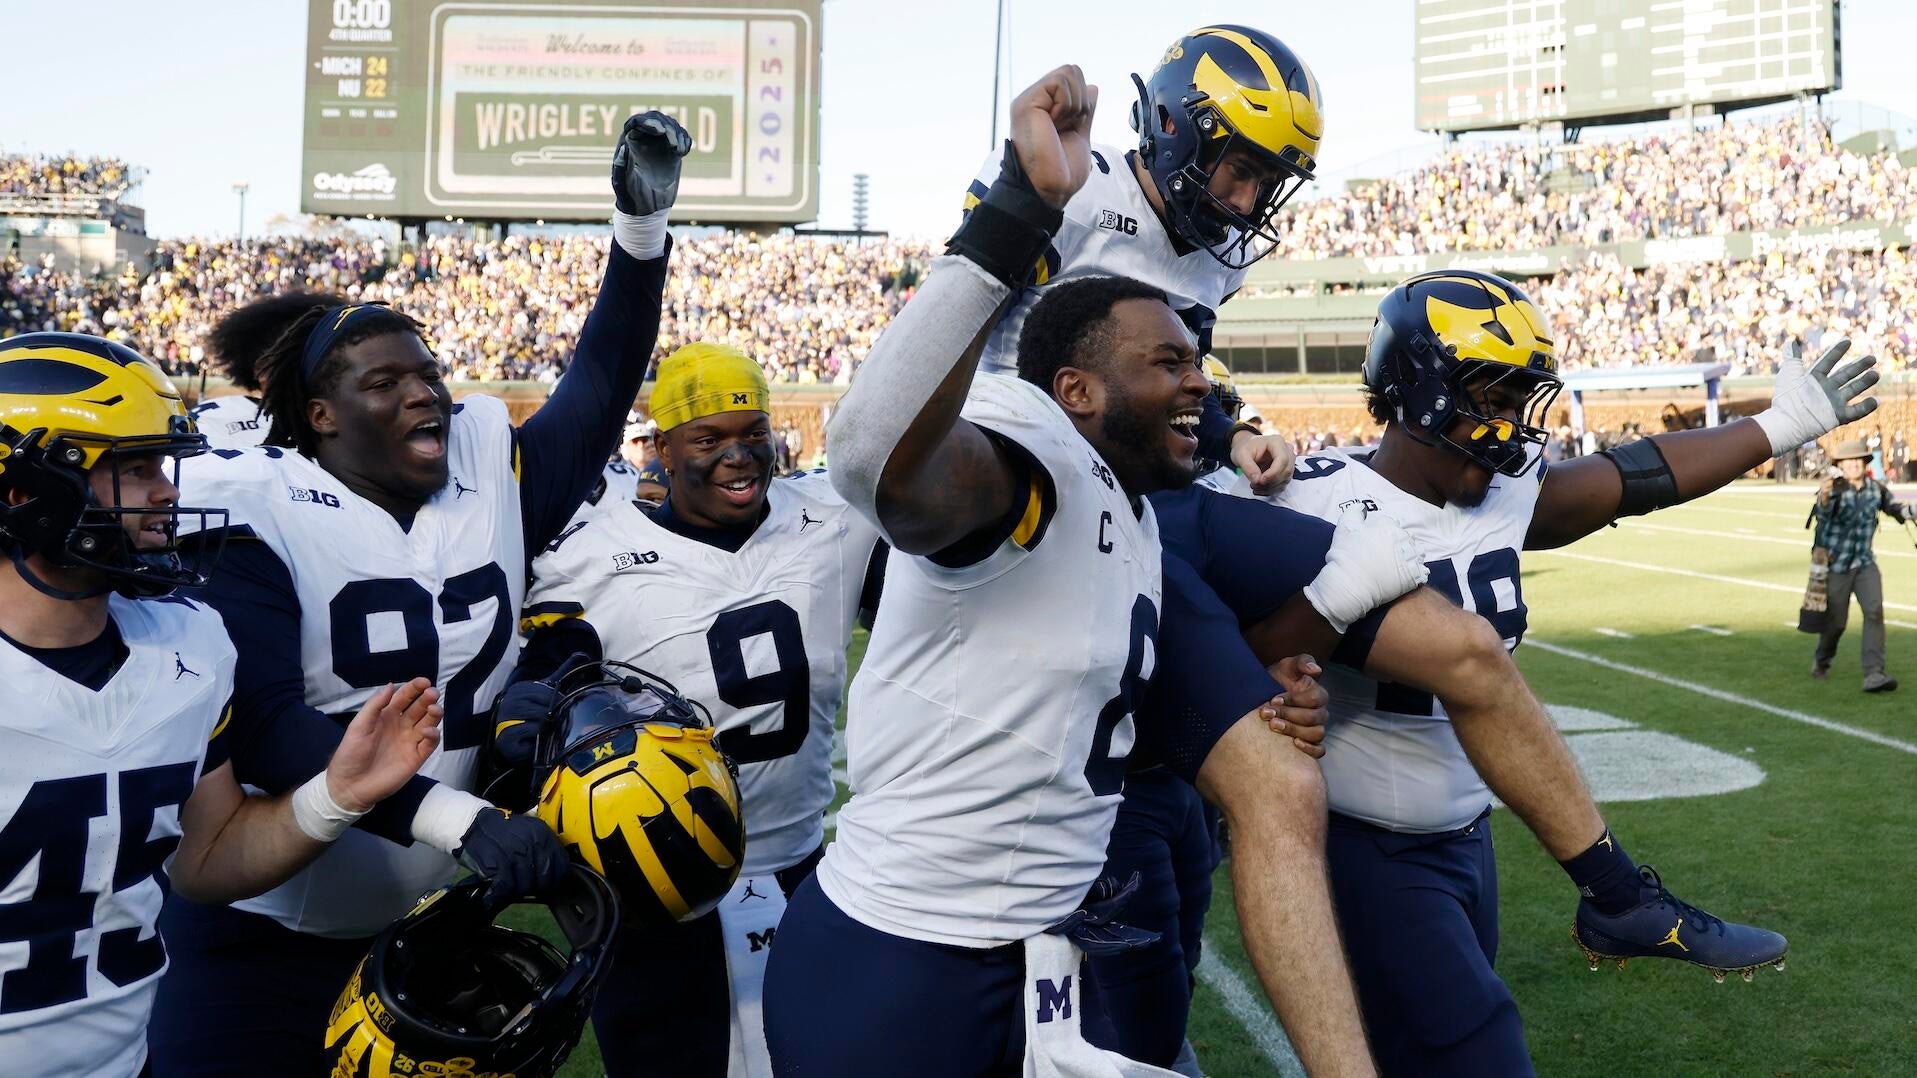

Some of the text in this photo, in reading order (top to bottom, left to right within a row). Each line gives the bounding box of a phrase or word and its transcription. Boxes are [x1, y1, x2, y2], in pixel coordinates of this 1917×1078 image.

[333, 0, 391, 28] 0:00
[545, 33, 622, 54] Welcome
[626, 40, 645, 55] to
[366, 56, 387, 75] 24
[462, 64, 728, 80] THE FRIENDLY CONFINES OF
[365, 78, 386, 97] 22
[475, 103, 619, 150] WRIGLEY
[732, 393, 748, 404] M
[1098, 511, 1113, 554] C
[329, 561, 513, 752] 92
[706, 599, 810, 765] 9
[0, 761, 198, 1015] 45
[746, 928, 776, 953] M
[1036, 975, 1072, 1024] M
